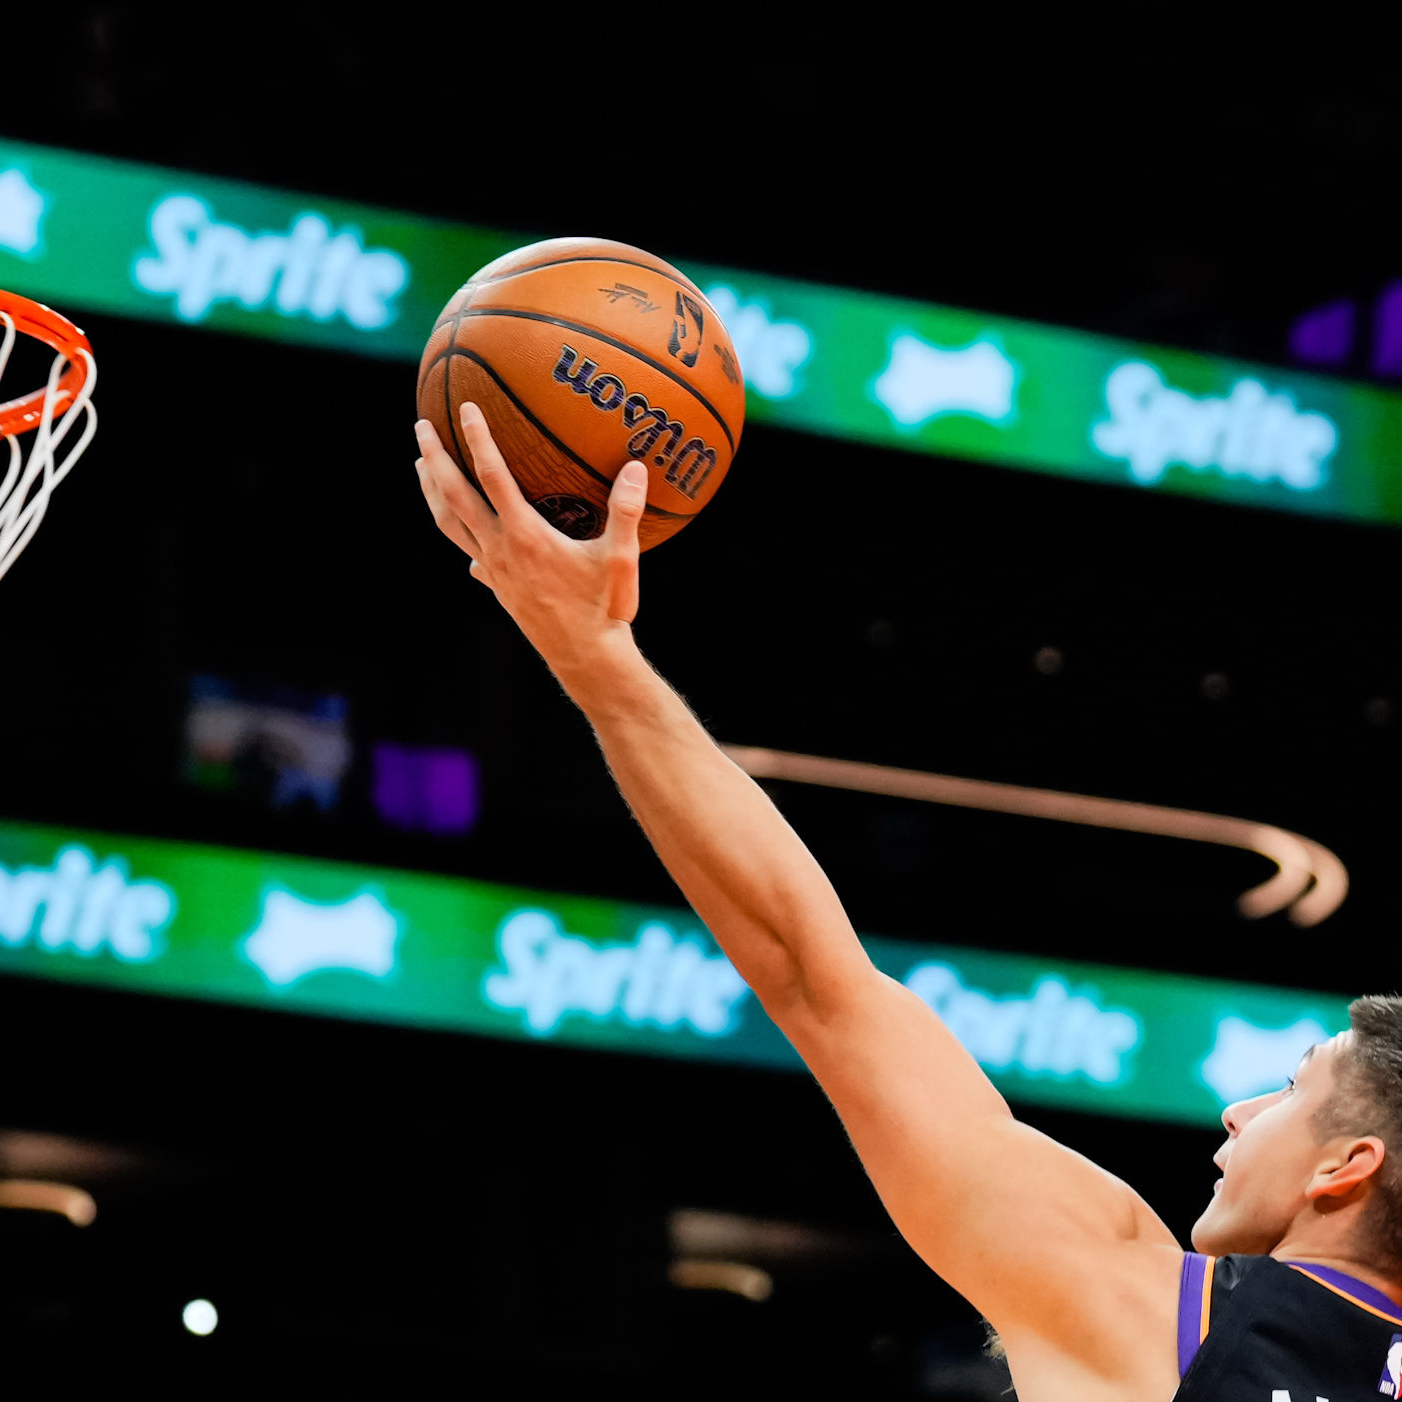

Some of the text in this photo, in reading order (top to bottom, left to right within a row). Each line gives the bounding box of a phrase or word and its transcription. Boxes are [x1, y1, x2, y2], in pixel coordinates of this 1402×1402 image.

[131, 192, 410, 332] Sprite
[552, 343, 718, 501] Wilson
[1090, 360, 1340, 490] Sprite
[482, 908, 750, 1036] Sprite
